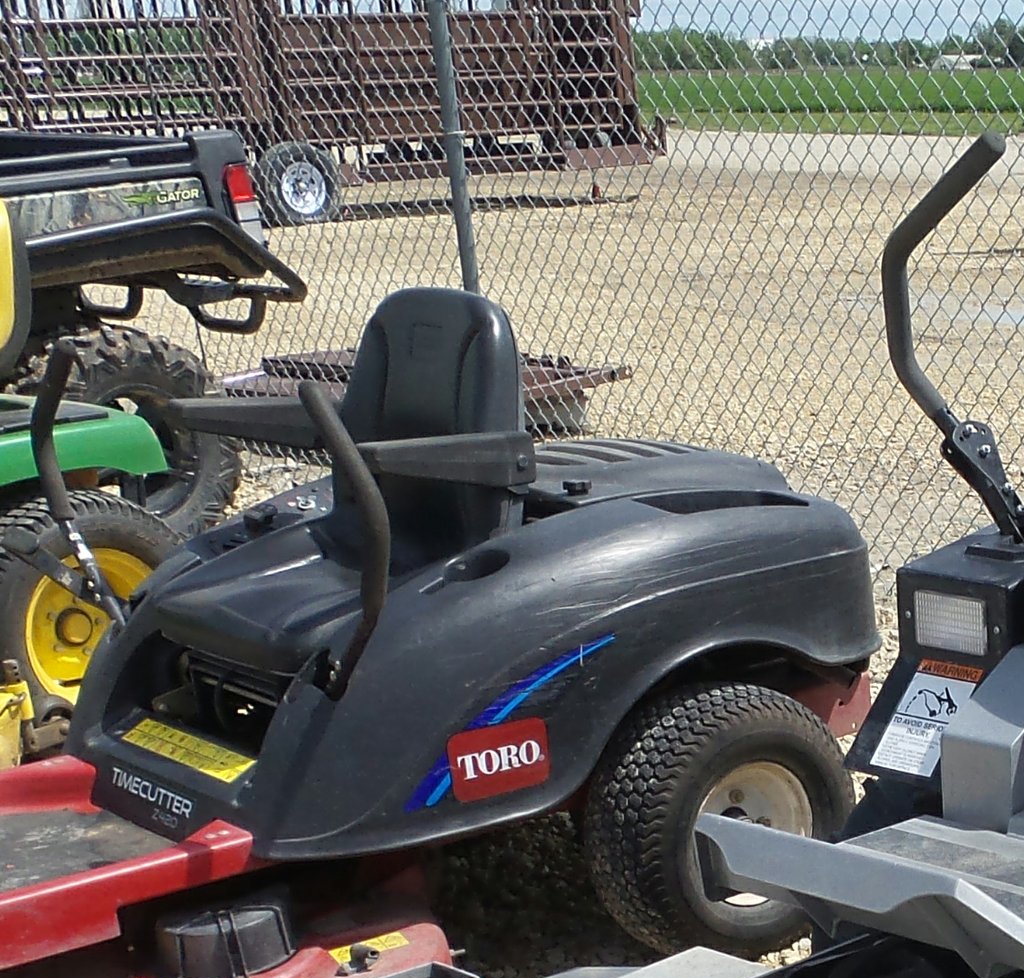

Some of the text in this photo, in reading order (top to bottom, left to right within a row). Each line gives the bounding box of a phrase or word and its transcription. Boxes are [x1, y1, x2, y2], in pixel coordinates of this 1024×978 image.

[156, 188, 199, 204] GATOR
[933, 663, 978, 680] WARNING
[893, 716, 903, 724] TO
[902, 718, 923, 728] AVOID
[906, 727, 930, 738] INJURY
[457, 740, 541, 780] TORO
[112, 767, 193, 819] TIMECUTTER
